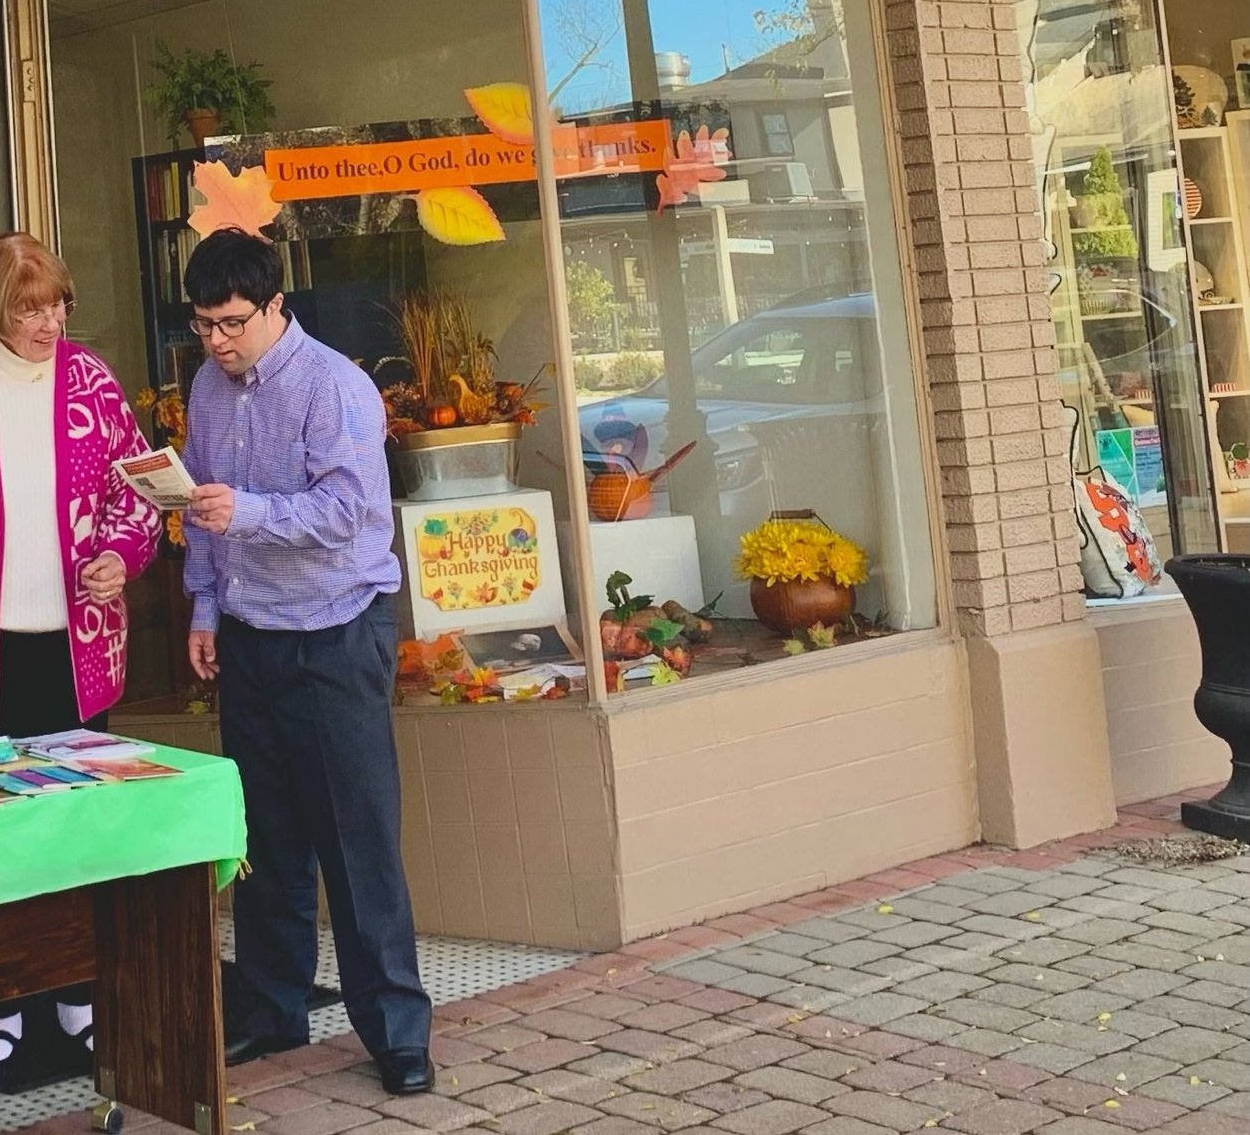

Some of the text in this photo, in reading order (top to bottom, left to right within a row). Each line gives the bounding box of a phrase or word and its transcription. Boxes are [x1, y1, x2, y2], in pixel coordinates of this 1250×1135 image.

[278, 162, 329, 182] Unto
[408, 149, 460, 173] God,
[465, 148, 490, 166] do
[496, 148, 526, 165] we
[445, 531, 509, 556] Happy
[422, 555, 539, 583] Thanksgiving
